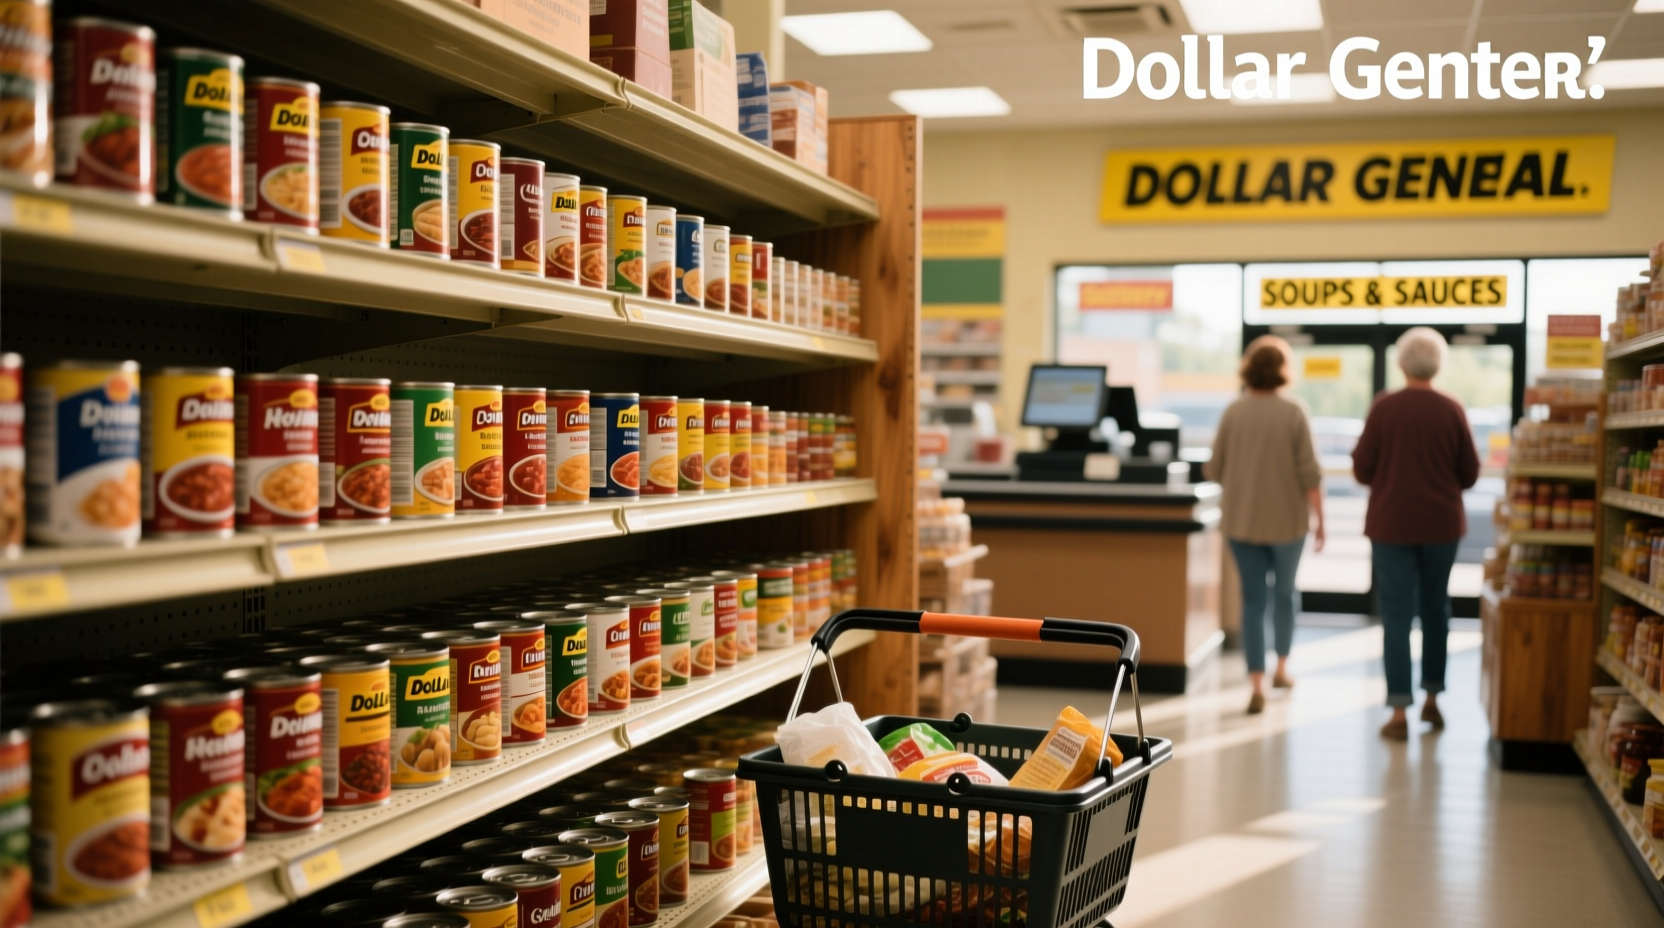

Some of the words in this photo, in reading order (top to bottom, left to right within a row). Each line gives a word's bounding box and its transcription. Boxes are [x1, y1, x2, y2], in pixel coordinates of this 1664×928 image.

[1122, 159, 1336, 207] DOLLAR
[1263, 280, 1354, 306] SOUPS
[1364, 280, 1382, 306] &
[1395, 278, 1502, 305] SAUCES
